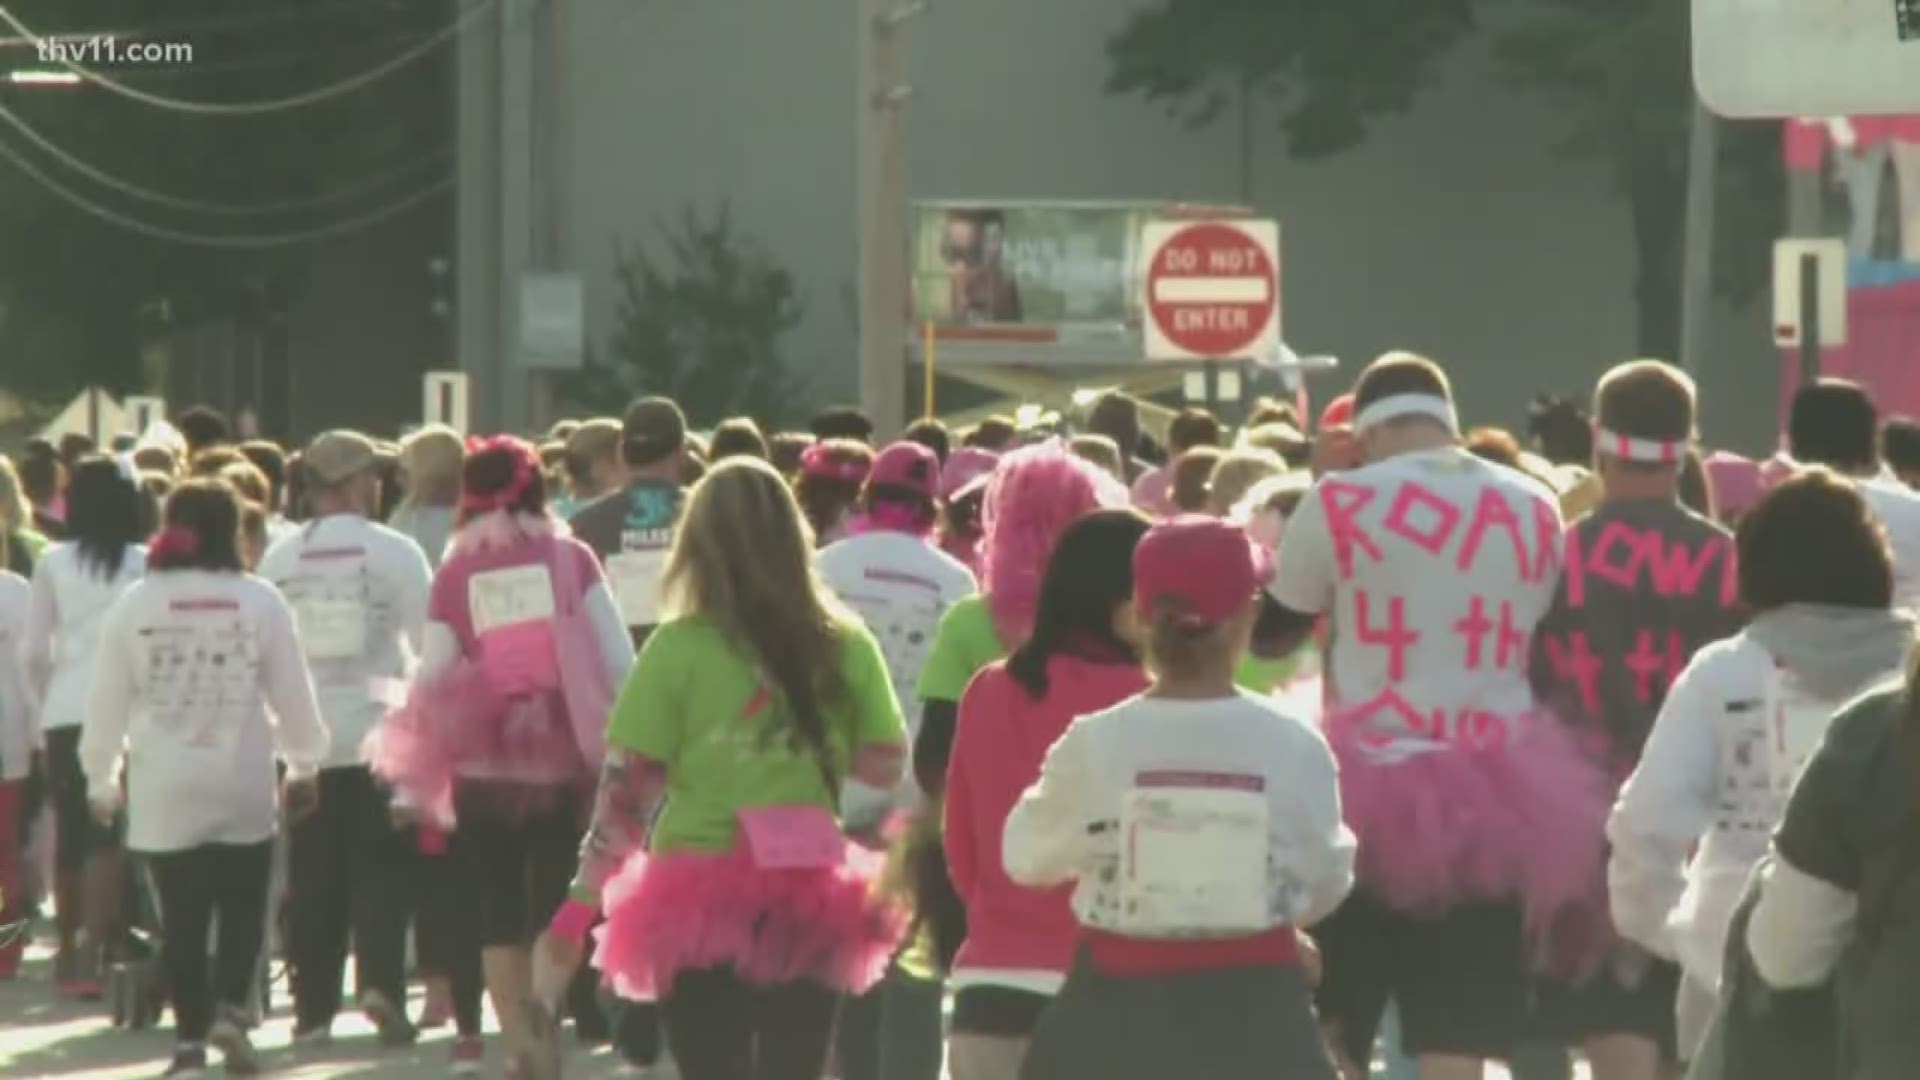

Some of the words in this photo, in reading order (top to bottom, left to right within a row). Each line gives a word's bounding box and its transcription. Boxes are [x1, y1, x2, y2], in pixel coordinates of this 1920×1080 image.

[1166, 248, 1198, 271] DO
[1210, 248, 1256, 271] NOT
[1174, 308, 1249, 331] ENTER
[1354, 588, 1420, 682] 4
[1452, 594, 1532, 670] th
[1544, 628, 1603, 712] 4
